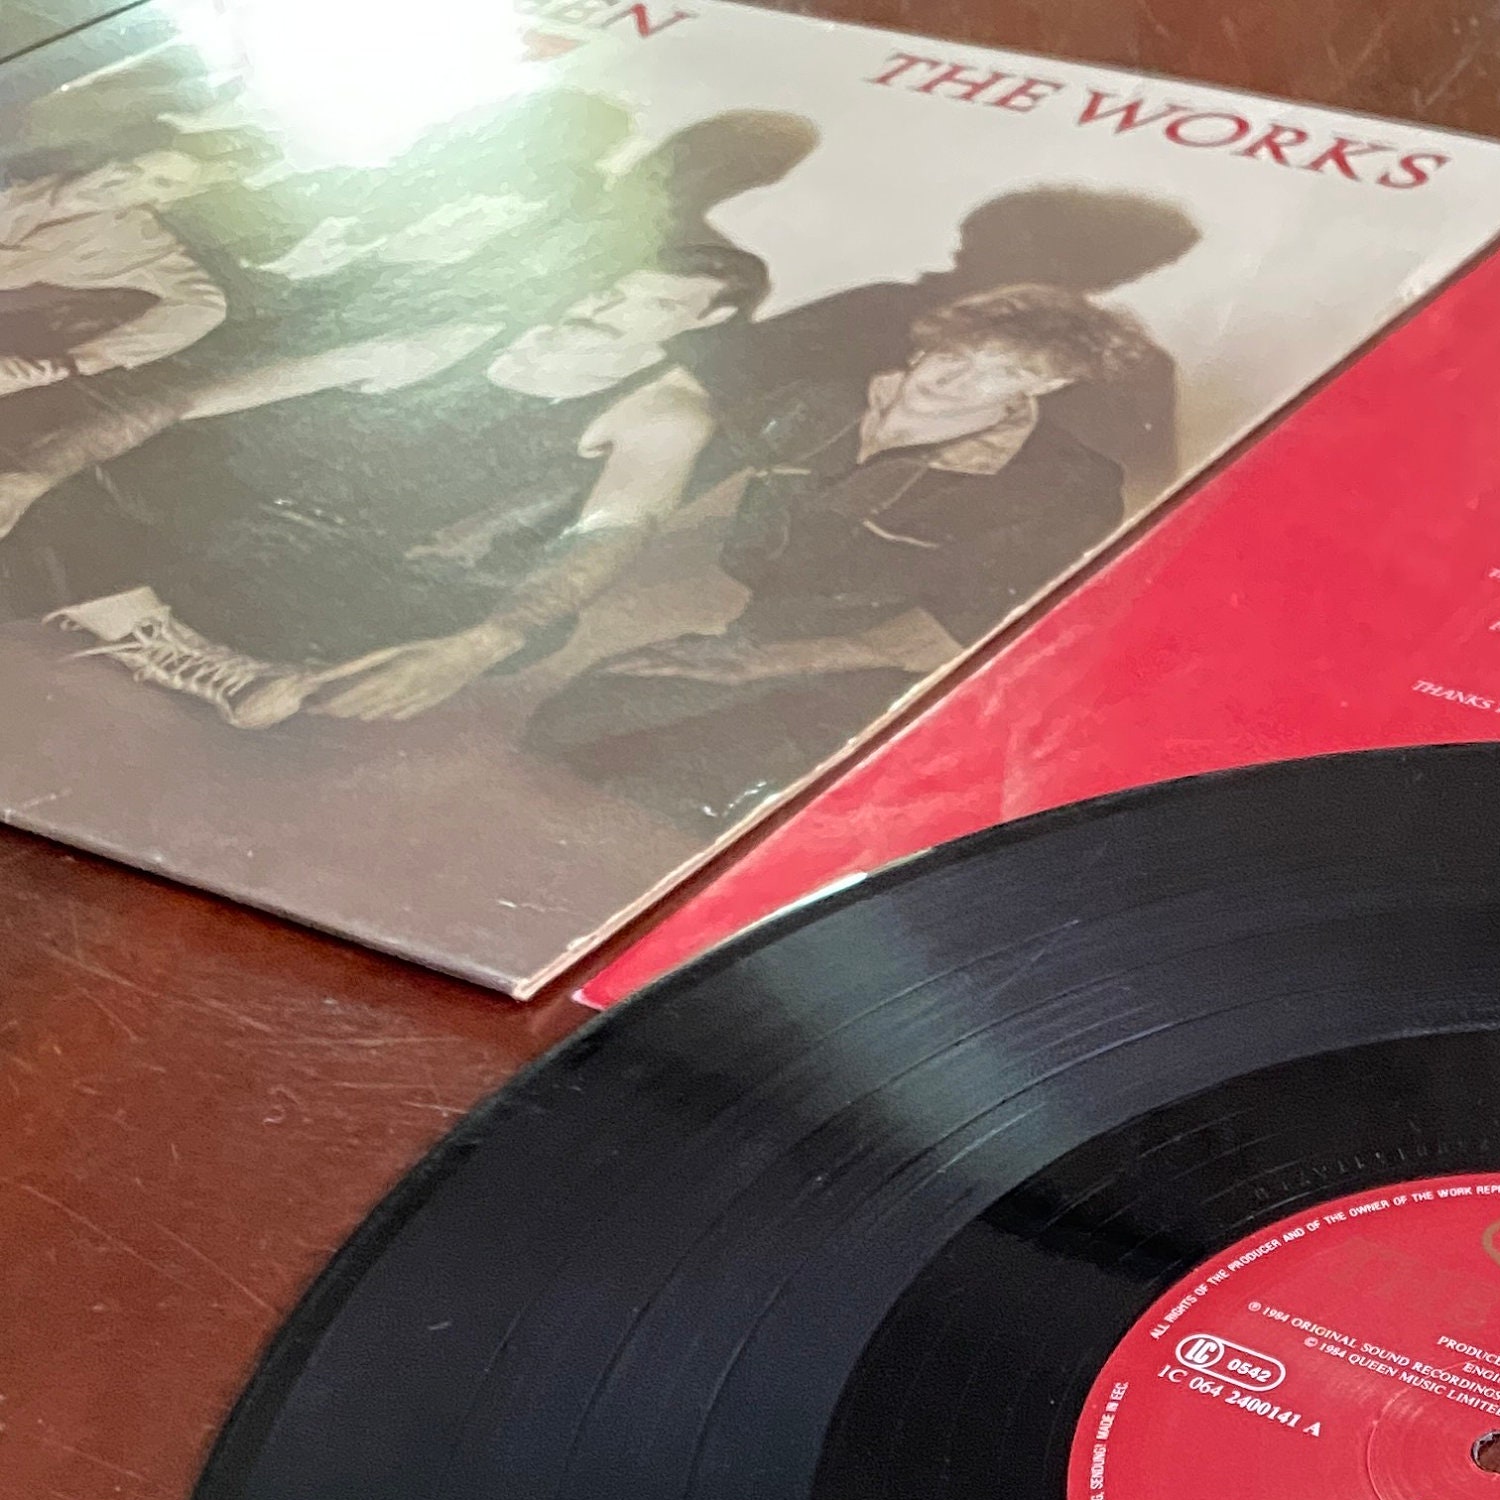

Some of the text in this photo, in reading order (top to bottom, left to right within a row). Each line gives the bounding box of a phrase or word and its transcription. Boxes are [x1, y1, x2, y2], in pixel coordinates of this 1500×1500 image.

[867, 54, 1451, 190] THE WORKS
[1413, 680, 1494, 709] THANKS
[1150, 1324, 1170, 1339] ALL
[1164, 1295, 1197, 1323] RIGHTS
[1194, 1284, 1208, 1296] OF
[1207, 1269, 1230, 1285] THE
[1227, 1239, 1281, 1271] PRODUCER
[1283, 1228, 1305, 1242] AND
[1306, 1220, 1320, 1231] OF
[1323, 1212, 1347, 1224] THE
[1349, 1200, 1390, 1217] OWNER
[1393, 1195, 1407, 1206] OF
[1411, 1191, 1434, 1202] THE
[1437, 1187, 1472, 1198] WORK
[1263, 1307, 1290, 1322] 1984
[1291, 1318, 1356, 1348] ORIGINAL
[1360, 1343, 1410, 1366] SOUND
[1227, 1359, 1271, 1382] 0542
[1319, 1343, 1347, 1358] 1984
[1348, 1354, 1398, 1376] QUEEN
[1399, 1371, 1446, 1394] MUSIC
[1096, 1414, 1115, 1439] MADE
[1106, 1402, 1119, 1412] IN
[1189, 1377, 1224, 1397] 064
[1225, 1390, 1301, 1427] 2400141
[1303, 1422, 1320, 1436] A
